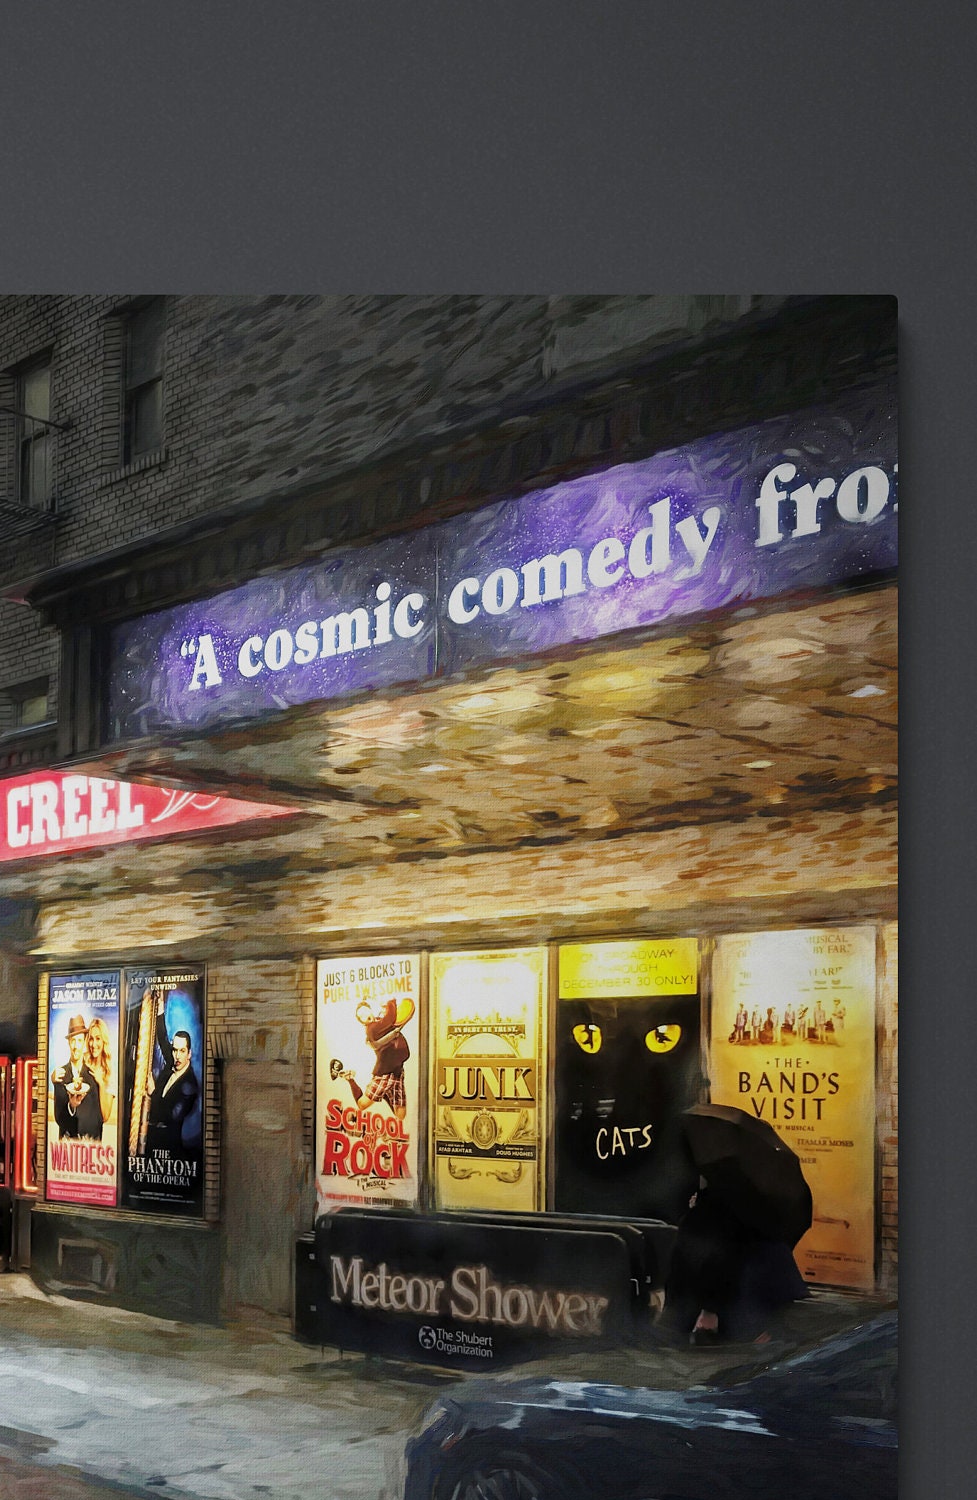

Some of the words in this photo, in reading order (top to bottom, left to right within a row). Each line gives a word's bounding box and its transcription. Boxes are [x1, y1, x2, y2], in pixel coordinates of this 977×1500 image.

[180, 633, 223, 692] “A
[238, 582, 424, 678] cosmic
[448, 497, 722, 625] comedy
[755, 462, 898, 548] fro
[6, 774, 144, 849] CREEL
[813, 945, 825, 954] BY
[163, 974, 199, 982] FANTASIES
[324, 971, 346, 987] JUST
[349, 970, 355, 983] 6
[358, 962, 395, 981] BLOCKS
[398, 960, 411, 975] TO
[562, 977, 632, 989] DECEMBER
[636, 976, 651, 986] 30
[654, 974, 694, 985] ONLY!
[52, 989, 84, 1003] JASON
[87, 988, 117, 1001] MRAZ
[324, 985, 350, 1004] PURE
[355, 975, 413, 999] AWESOME
[774, 1057, 802, 1068] THE
[439, 1066, 535, 1101] JUNK
[738, 1071, 840, 1095] BAND'S
[325, 1098, 410, 1141] SCHOOL
[751, 1097, 827, 1120] VISIT
[596, 1124, 653, 1160] CATS
[50, 1142, 115, 1176] WAITRESS
[152, 1149, 171, 1159] THE
[322, 1131, 412, 1178] ROCK
[127, 1156, 197, 1177] PHANTOM
[133, 1172, 144, 1182] OF
[145, 1173, 162, 1183] THE
[162, 1175, 190, 1186] OPERA
[365, 1179, 387, 1188] MUSICAL
[330, 1255, 444, 1316] Meteor
[450, 1265, 609, 1332] Shower
[436, 1328, 454, 1341] The
[455, 1330, 493, 1347] Shubert
[436, 1340, 493, 1358] Organization
